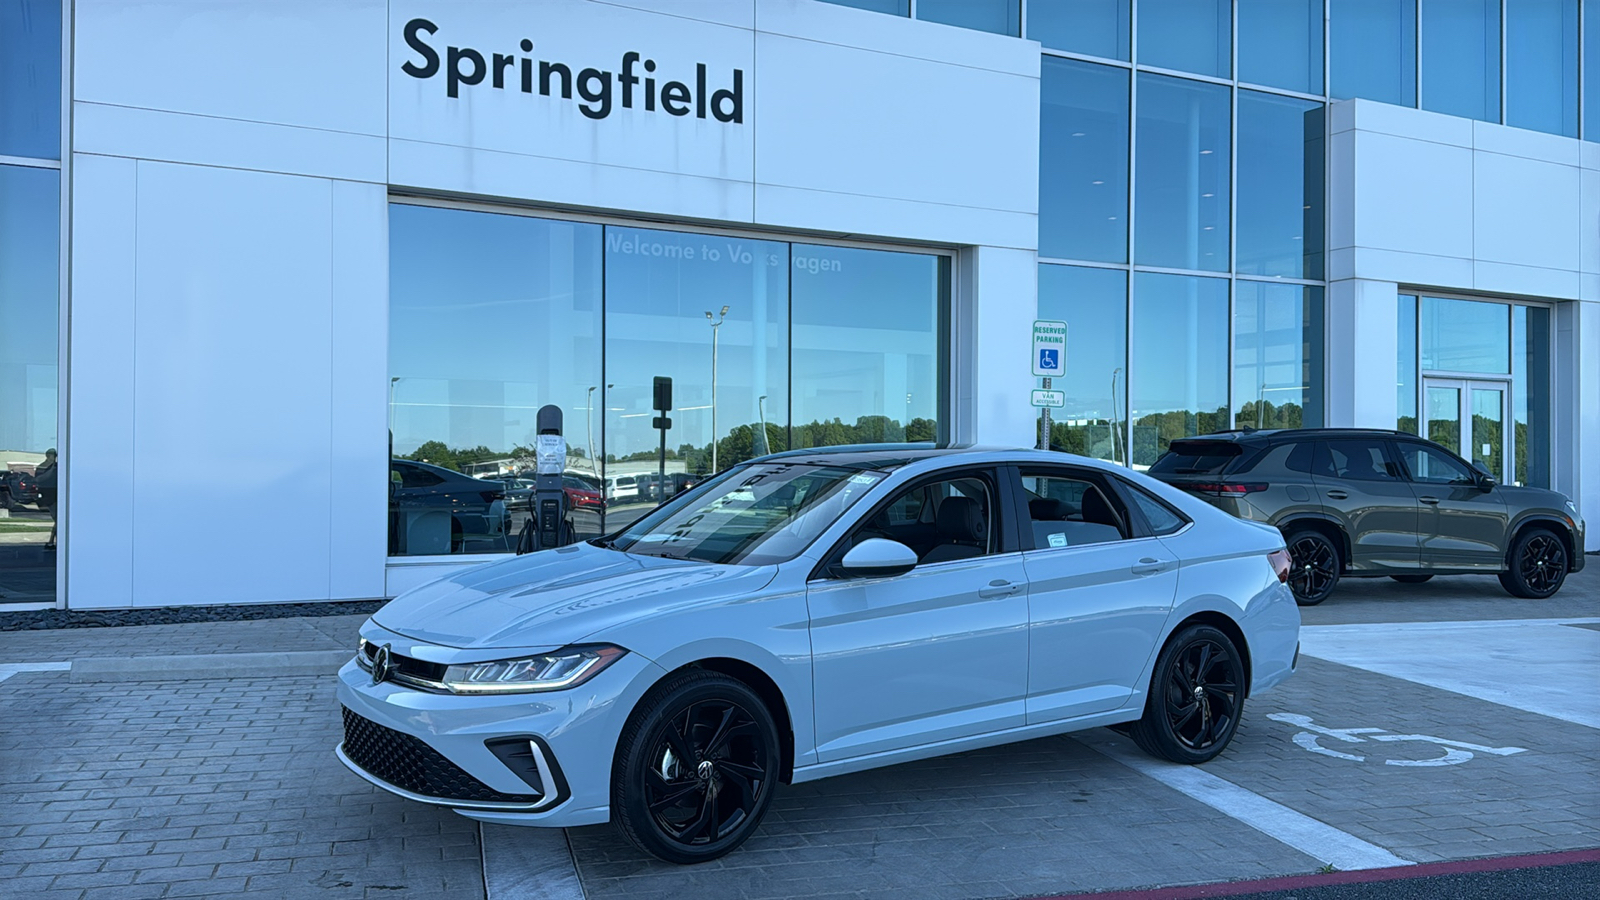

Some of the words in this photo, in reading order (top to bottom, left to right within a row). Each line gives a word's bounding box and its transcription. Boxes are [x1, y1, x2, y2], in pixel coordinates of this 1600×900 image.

[401, 18, 744, 124] Springfield
[605, 232, 695, 259] Welcome
[701, 244, 721, 262] to
[1034, 326, 1065, 334] RESERVED
[1036, 335, 1063, 343] PARKING
